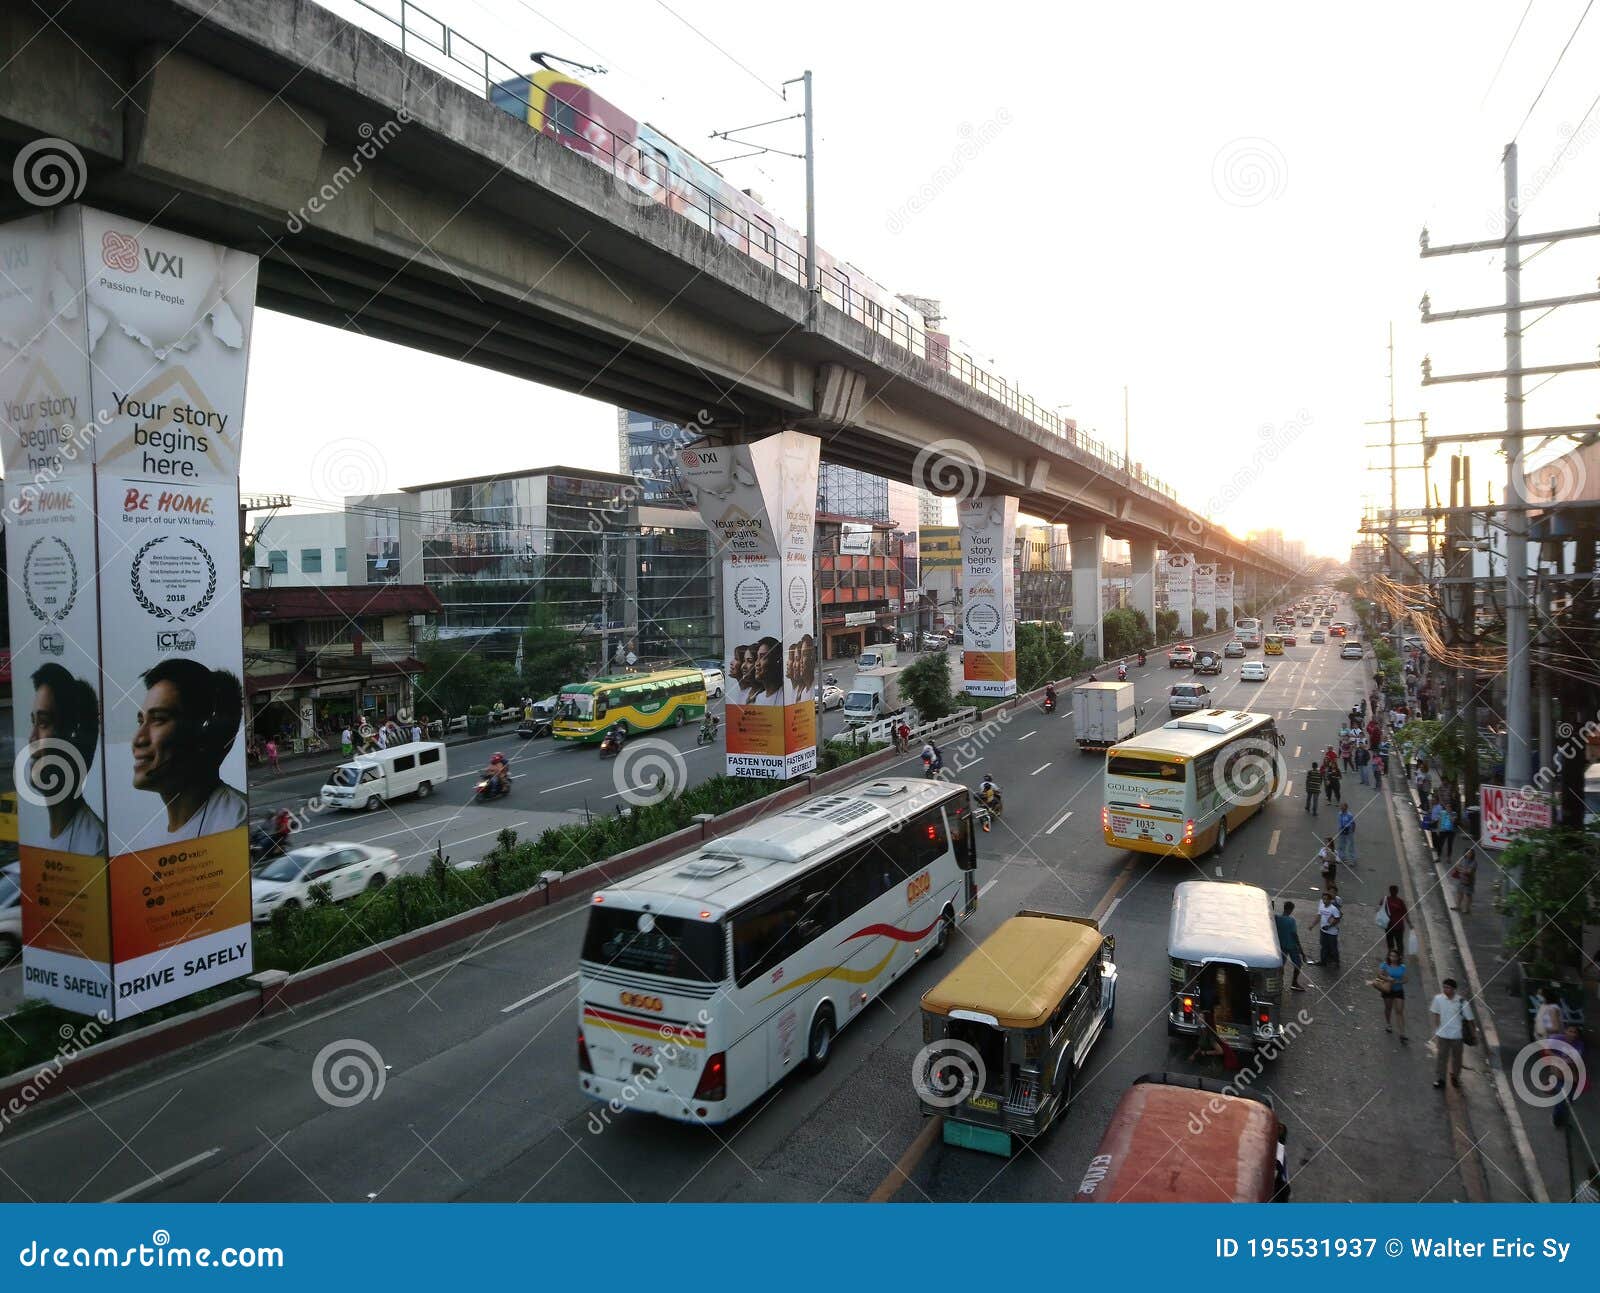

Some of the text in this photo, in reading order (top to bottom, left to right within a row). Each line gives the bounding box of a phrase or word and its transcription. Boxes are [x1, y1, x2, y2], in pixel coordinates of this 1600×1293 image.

[144, 248, 183, 279] VXI
[100, 278, 185, 305] Passion for People
[4, 396, 77, 423] Your story
[112, 392, 228, 434] Your story
[134, 424, 209, 453] begins
[142, 452, 199, 477] here.
[698, 452, 718, 464] VXI
[124, 488, 214, 515] BE HOME.
[123, 514, 133, 522] Be
[135, 515, 152, 525] part
[153, 516, 162, 524] of
[178, 516, 191, 525] VXI
[192, 517, 216, 526] family.
[712, 517, 762, 529] Your story
[724, 527, 758, 542] begins
[971, 536, 991, 545] Your
[732, 538, 758, 549] here.
[970, 546, 993, 555] story
[968, 555, 997, 566] begins
[971, 566, 993, 574] here.
[166, 594, 186, 602] 2018
[156, 633, 178, 651] ICT
[728, 757, 783, 768] FASTEN YOUR
[1107, 783, 1148, 794] GOLDEN
[1483, 788, 1504, 821] NO
[1136, 820, 1155, 830] 1032
[119, 942, 248, 999] DRIVE SAFELY
[25, 965, 108, 1000] DRIVE SAFELY
